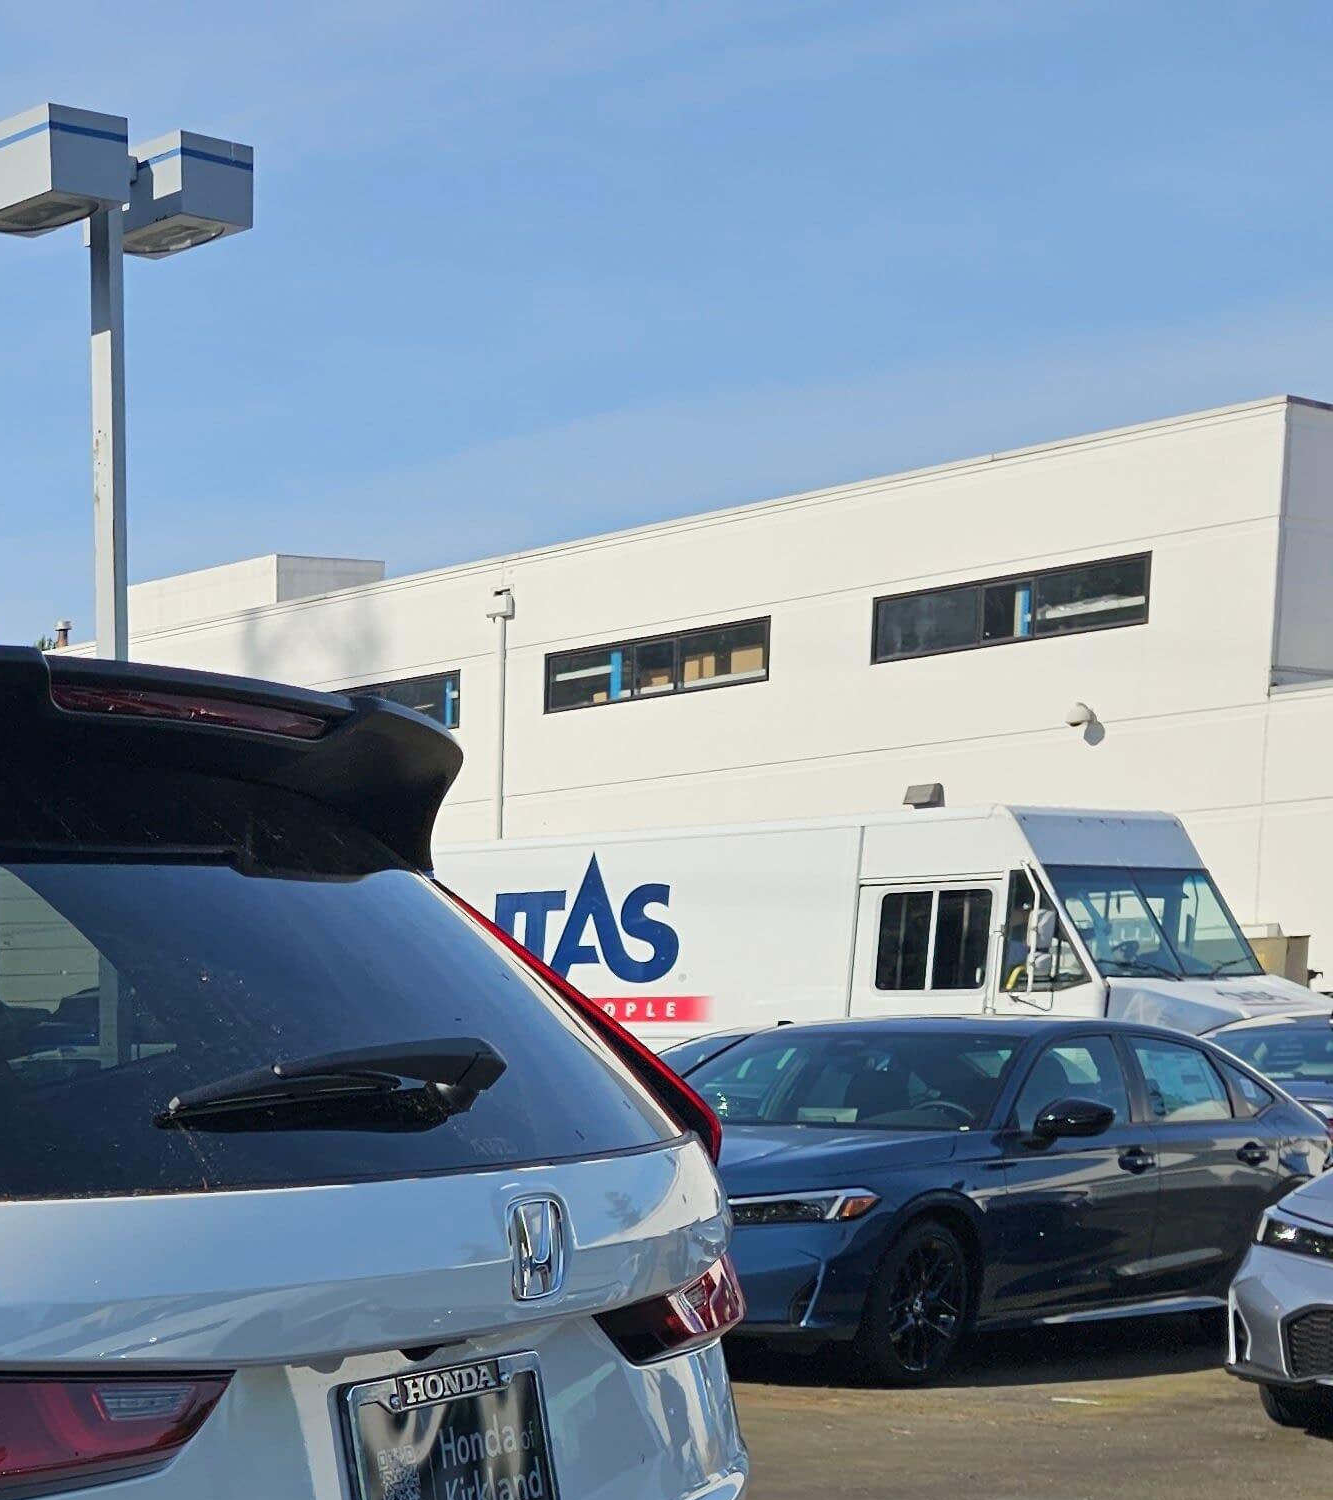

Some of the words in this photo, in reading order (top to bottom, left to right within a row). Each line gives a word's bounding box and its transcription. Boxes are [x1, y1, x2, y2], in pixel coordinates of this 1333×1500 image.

[404, 1364, 496, 1404] HONDA
[438, 1414, 518, 1469] Honda
[520, 1423, 535, 1450] of
